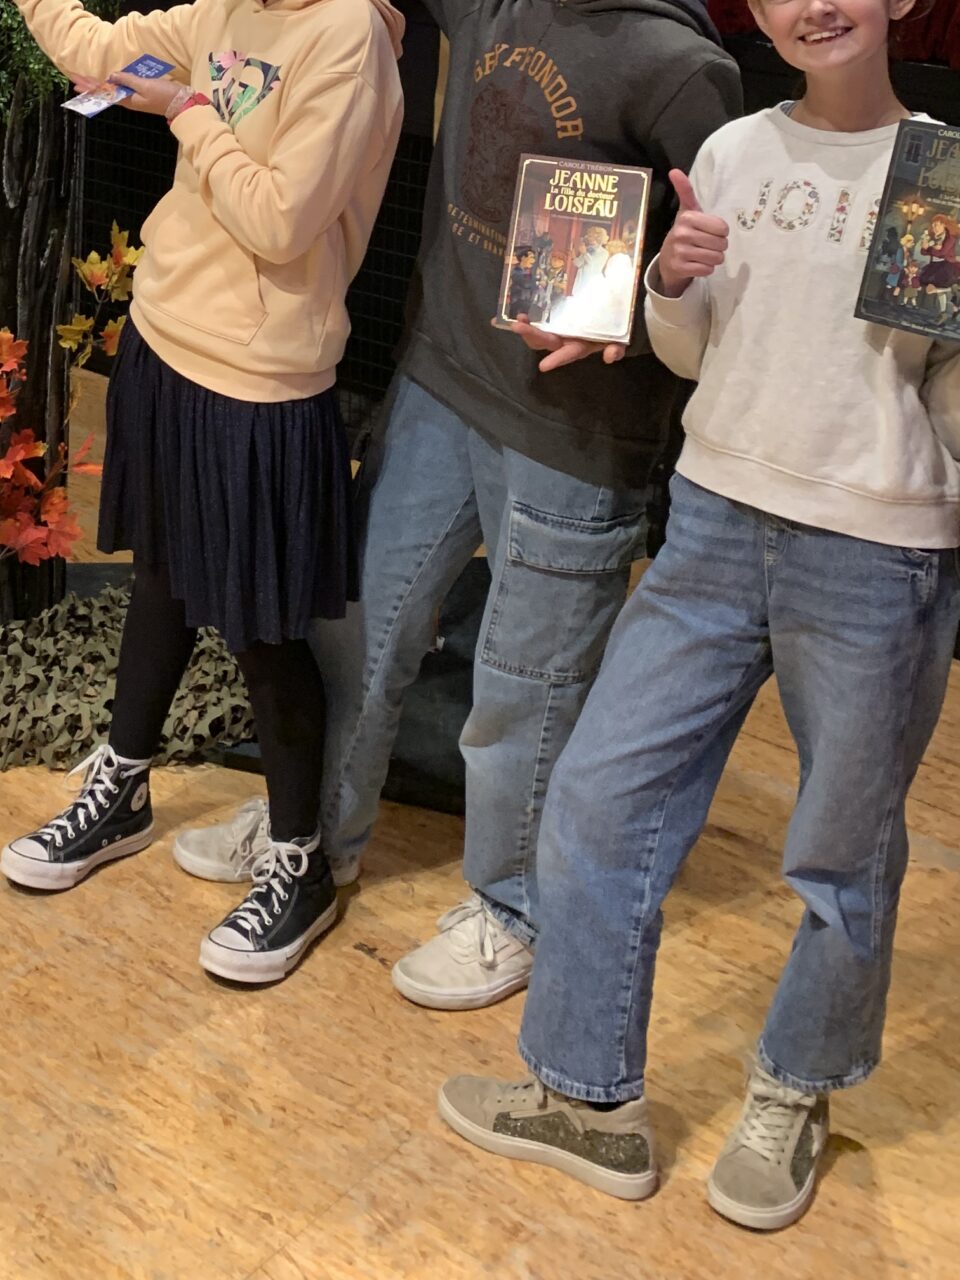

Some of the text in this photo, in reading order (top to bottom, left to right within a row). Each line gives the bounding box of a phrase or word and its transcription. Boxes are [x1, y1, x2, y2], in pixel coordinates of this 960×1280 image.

[559, 161, 585, 170] CAROLE
[549, 169, 619, 193] JEANNE
[550, 186, 559, 194] La
[576, 189, 586, 197] du
[544, 193, 619, 218] LOISEAU
